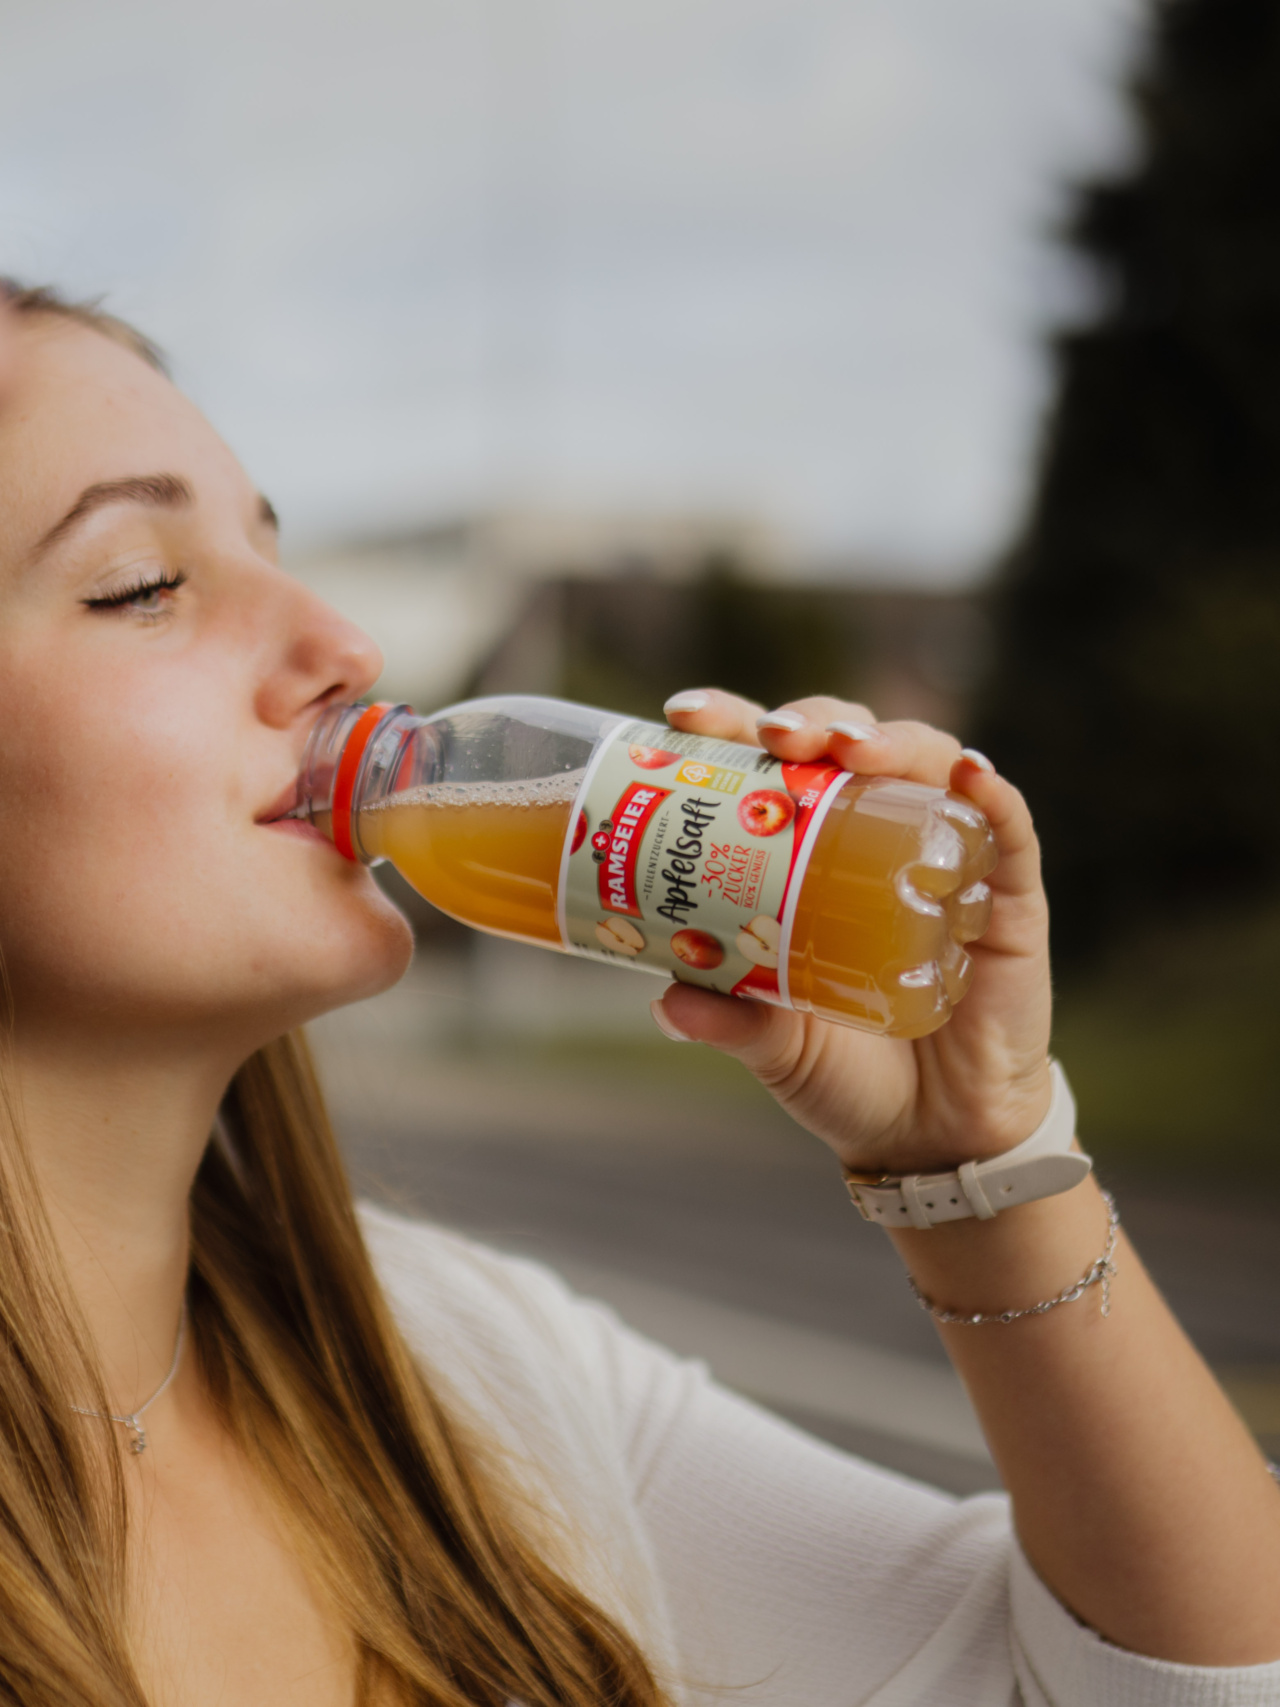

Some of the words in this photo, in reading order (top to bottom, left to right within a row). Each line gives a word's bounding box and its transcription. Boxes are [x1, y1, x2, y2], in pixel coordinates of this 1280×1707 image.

[799, 789, 820, 808] 33cl
[608, 789, 657, 910] RAMSEIER
[656, 797, 721, 926] Apfelsaft
[701, 842, 731, 898] -30%
[722, 844, 752, 905] ZUCKER
[749, 849, 767, 884] GENUSS
[744, 885, 756, 909] 100%
